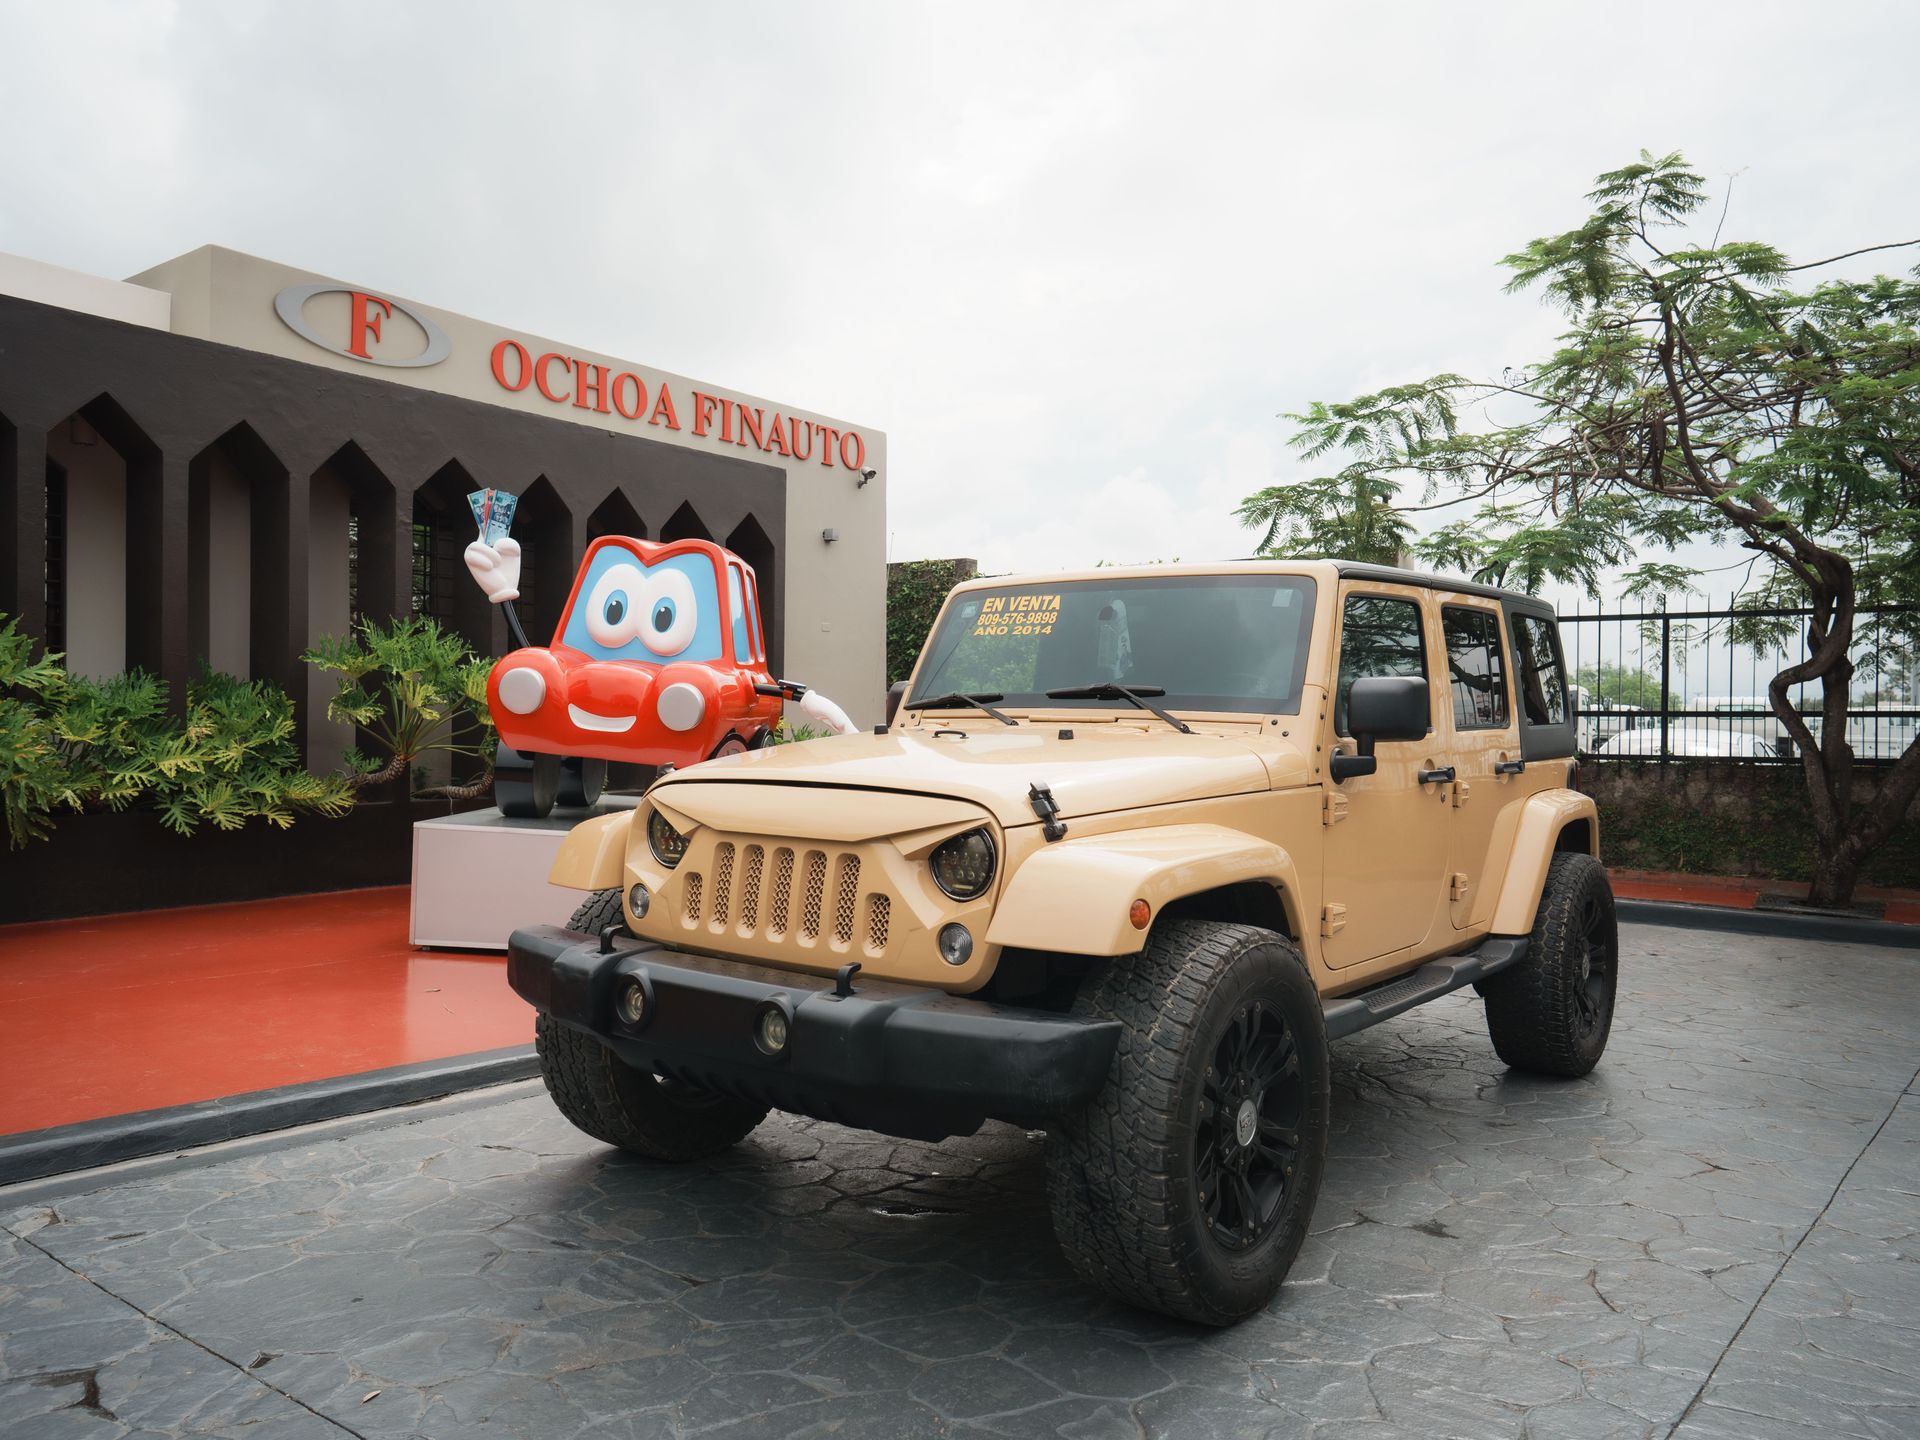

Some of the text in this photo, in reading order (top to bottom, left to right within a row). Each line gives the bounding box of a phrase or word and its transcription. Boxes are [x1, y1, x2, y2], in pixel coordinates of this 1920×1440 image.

[491, 340, 866, 470] OCHOA FINAUTO
[982, 595, 1061, 612] EN VENTA
[977, 612, 1058, 625] 809-576-9898
[1012, 625, 1051, 635] 2014
